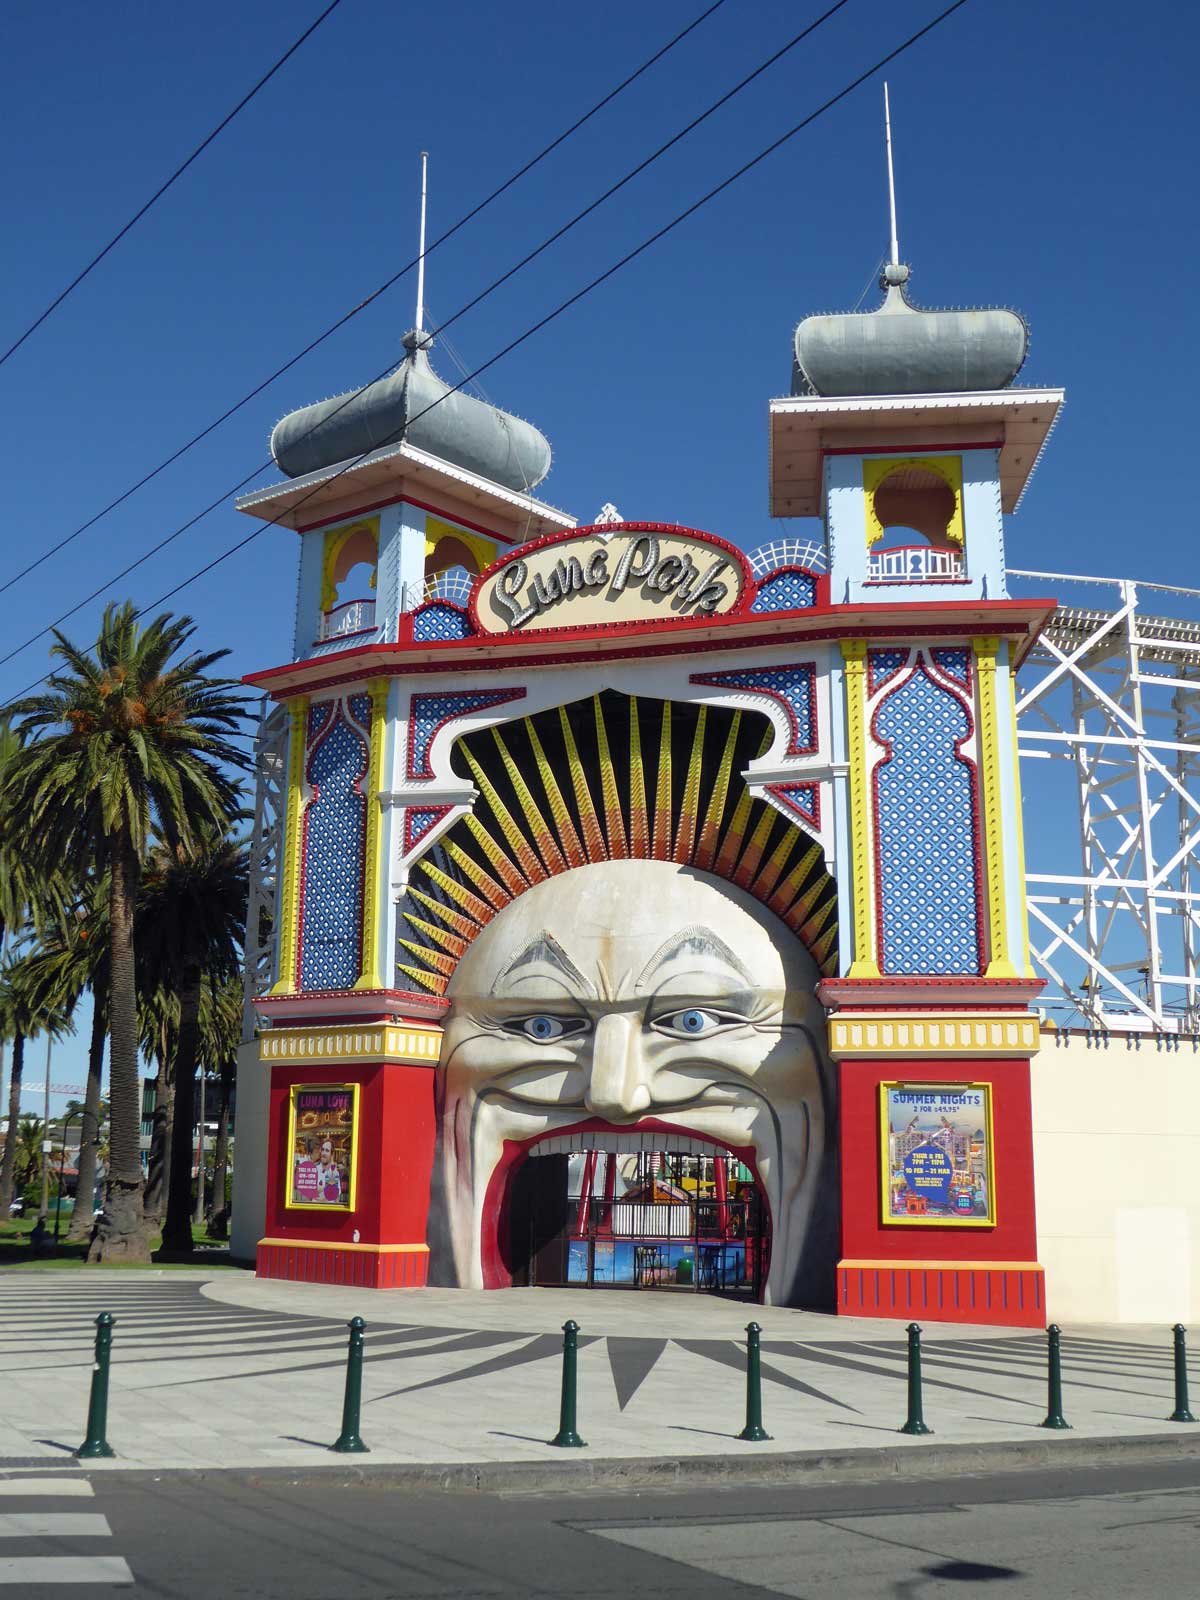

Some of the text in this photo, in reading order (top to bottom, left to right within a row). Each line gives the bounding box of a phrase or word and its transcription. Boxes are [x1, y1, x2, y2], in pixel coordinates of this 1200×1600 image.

[496, 533, 730, 627] Luna Park
[301, 1095, 324, 1108] LUNA
[893, 1094, 980, 1105] SUMMER NIGHTS
